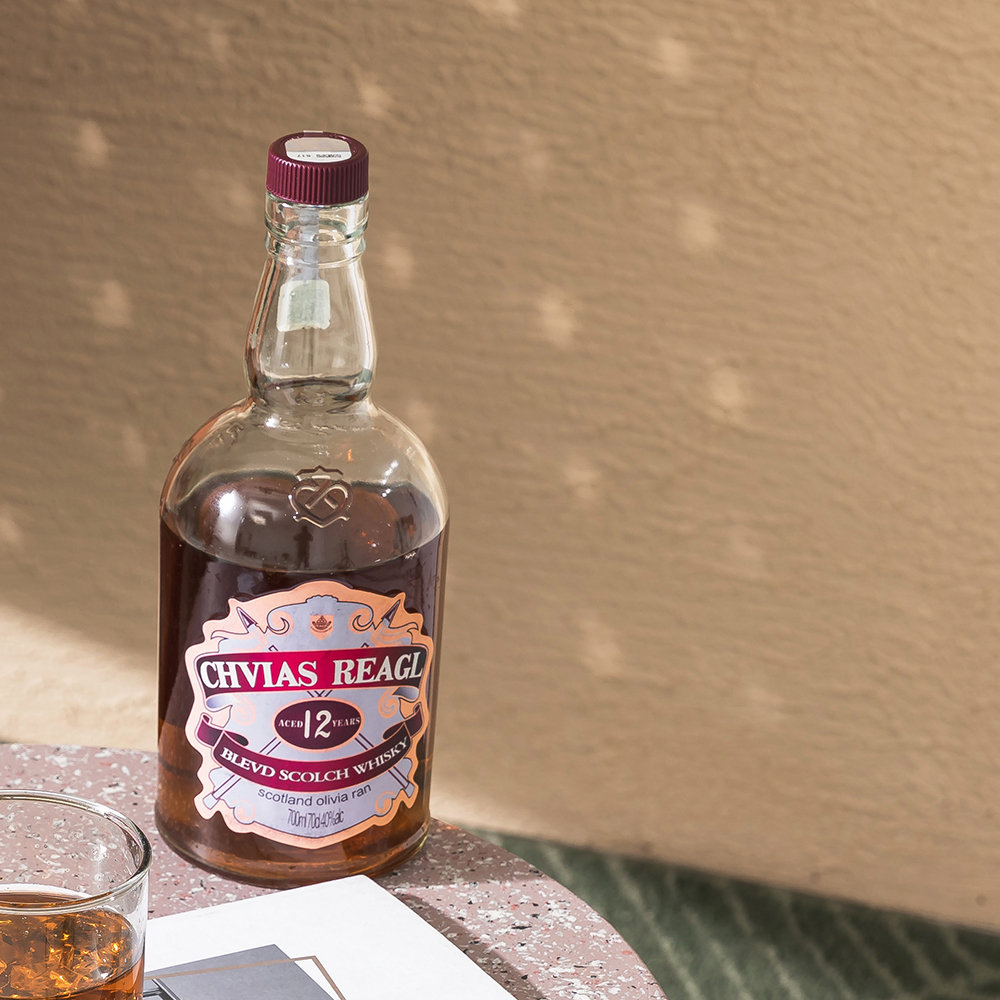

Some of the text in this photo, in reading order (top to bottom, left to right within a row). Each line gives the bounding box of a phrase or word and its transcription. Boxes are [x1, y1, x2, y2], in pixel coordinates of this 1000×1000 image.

[200, 651, 424, 689] CHVIAS REAGL
[303, 710, 330, 738] 12
[332, 716, 361, 727] YEARS
[220, 737, 408, 783] BLEVD SCOLCH WHISKY
[258, 784, 371, 806] scotland olivia ran
